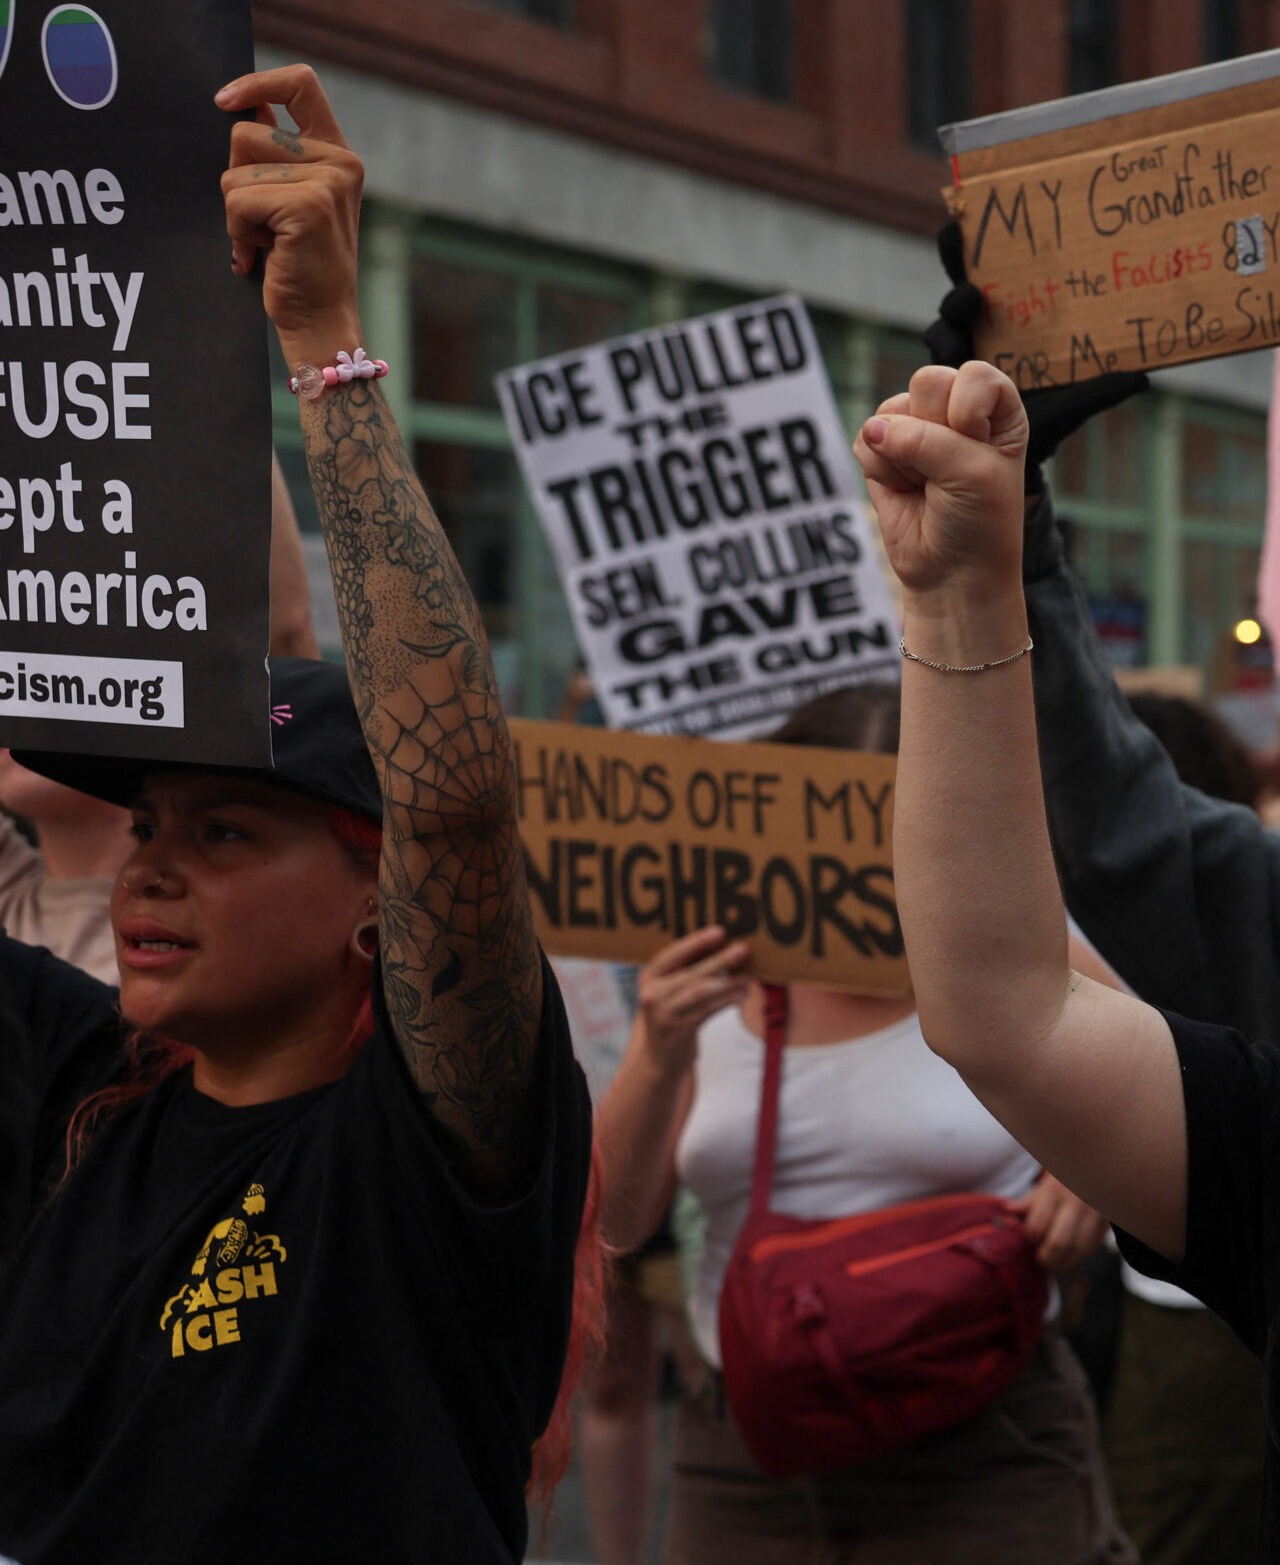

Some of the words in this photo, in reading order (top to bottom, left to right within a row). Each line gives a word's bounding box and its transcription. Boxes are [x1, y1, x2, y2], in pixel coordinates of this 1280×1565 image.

[0, 168, 125, 226] ame
[972, 180, 1062, 269] MY
[1088, 143, 1271, 236] Grandfather
[981, 279, 1060, 332] Fight
[1066, 270, 1107, 299] the
[0, 360, 152, 441] USE
[507, 360, 603, 445] ICE
[609, 305, 808, 412] PULLED
[614, 404, 729, 447] THE
[101, 479, 134, 534] a
[547, 417, 836, 562] TRIGGER
[0, 551, 208, 631] merica
[578, 556, 680, 630] SEN.
[688, 512, 862, 598] COLLINS
[617, 575, 863, 665] GAVE
[0, 663, 165, 721] cism.org
[614, 656, 741, 709] THE
[756, 623, 891, 676] GUN
[516, 737, 676, 825] HANDS
[687, 769, 781, 836] OFF
[803, 775, 894, 848] MY
[521, 836, 906, 959] NEIGHBORS
[171, 1307, 241, 1358] ICE
